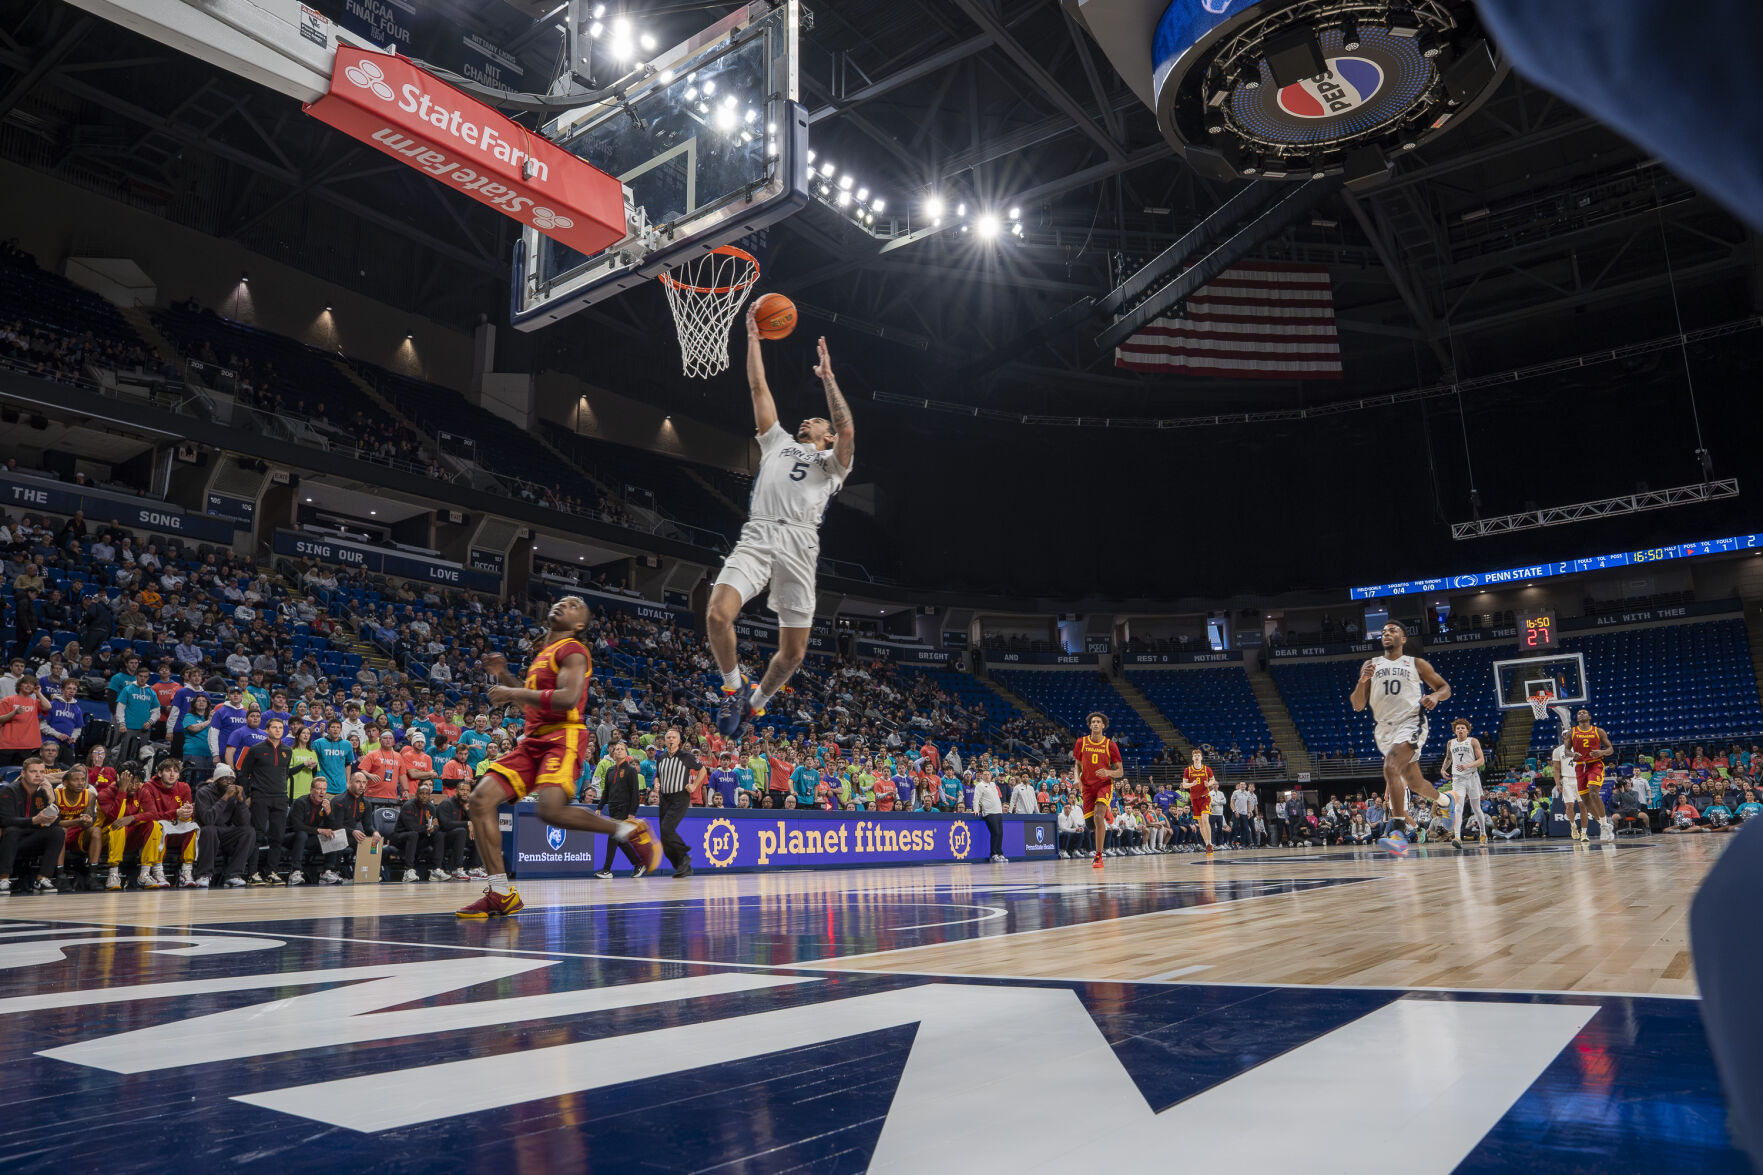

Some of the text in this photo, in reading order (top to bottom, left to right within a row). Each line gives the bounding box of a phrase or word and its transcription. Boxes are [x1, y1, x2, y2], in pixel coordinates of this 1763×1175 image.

[364, 0, 394, 21] NCAA
[346, 0, 377, 26] FINAL
[380, 19, 411, 43] FOUR
[485, 63, 501, 80] NIT
[1311, 70, 1352, 112] PEPS
[780, 446, 802, 458] PENN
[789, 462, 810, 481] 5
[12, 486, 48, 504] THE
[1747, 535, 1756, 547] 2
[296, 541, 364, 564] SING OUR
[1633, 548, 1664, 562] 16:50
[429, 567, 459, 582] LOVE
[1559, 562, 1567, 573] 2
[1485, 567, 1543, 583] PENN STATE
[637, 607, 675, 620] LOYALTY
[1597, 608, 1686, 625] ALL WITH THEE
[1526, 617, 1550, 628] 16:50
[754, 629, 768, 639] OUR
[1433, 628, 1517, 645] ALL WITH THEE
[1527, 628, 1549, 646] 27
[807, 638, 822, 646] PES
[873, 647, 949, 660] THAT BRIGHT
[1275, 643, 1373, 657] DEAR WITH THEE
[1194, 654, 1228, 662] MOTHER
[1375, 667, 1411, 681] PENN STATE
[1382, 679, 1401, 695] 10
[132, 693, 151, 701] THON
[1583, 739, 1590, 748] 2
[380, 758, 398, 766] THON
[1091, 753, 1099, 764] 0
[1458, 753, 1464, 762] 7
[712, 832, 729, 855] pf
[758, 821, 935, 865] planet fitness
[955, 831, 966, 846] pf
[564, 852, 592, 862] Health
